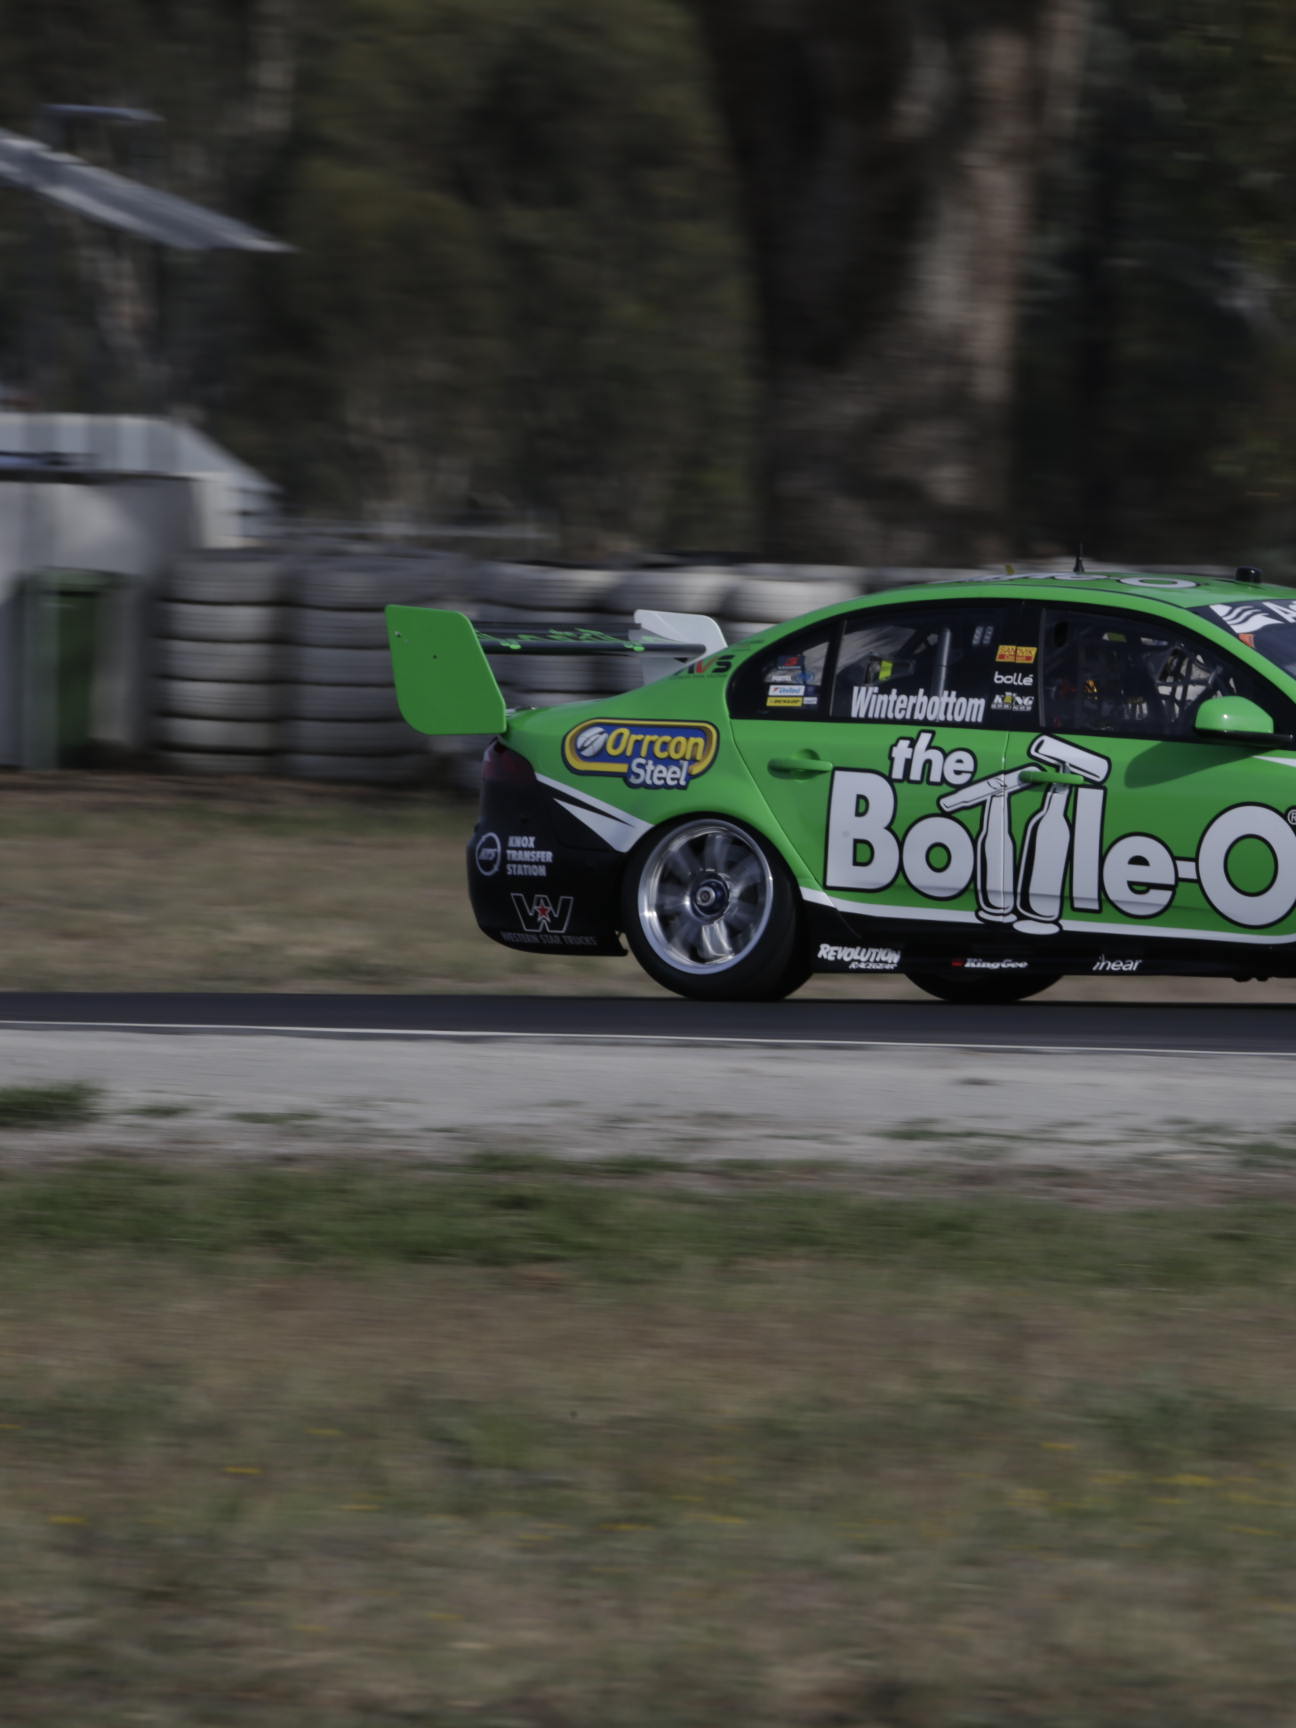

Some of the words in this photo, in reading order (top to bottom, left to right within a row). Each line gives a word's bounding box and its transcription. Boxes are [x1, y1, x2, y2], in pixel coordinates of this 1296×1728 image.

[993, 671, 1034, 686] bollé
[851, 686, 986, 723] Winterbottom
[605, 727, 705, 761] Orrcon
[891, 731, 976, 785] the
[629, 757, 689, 786] Steel
[507, 836, 536, 848] KNOX
[506, 849, 554, 863] TRANSFER
[506, 863, 547, 877] STATION
[817, 943, 902, 963] REVOLUTION
[964, 958, 1029, 969] KingGee
